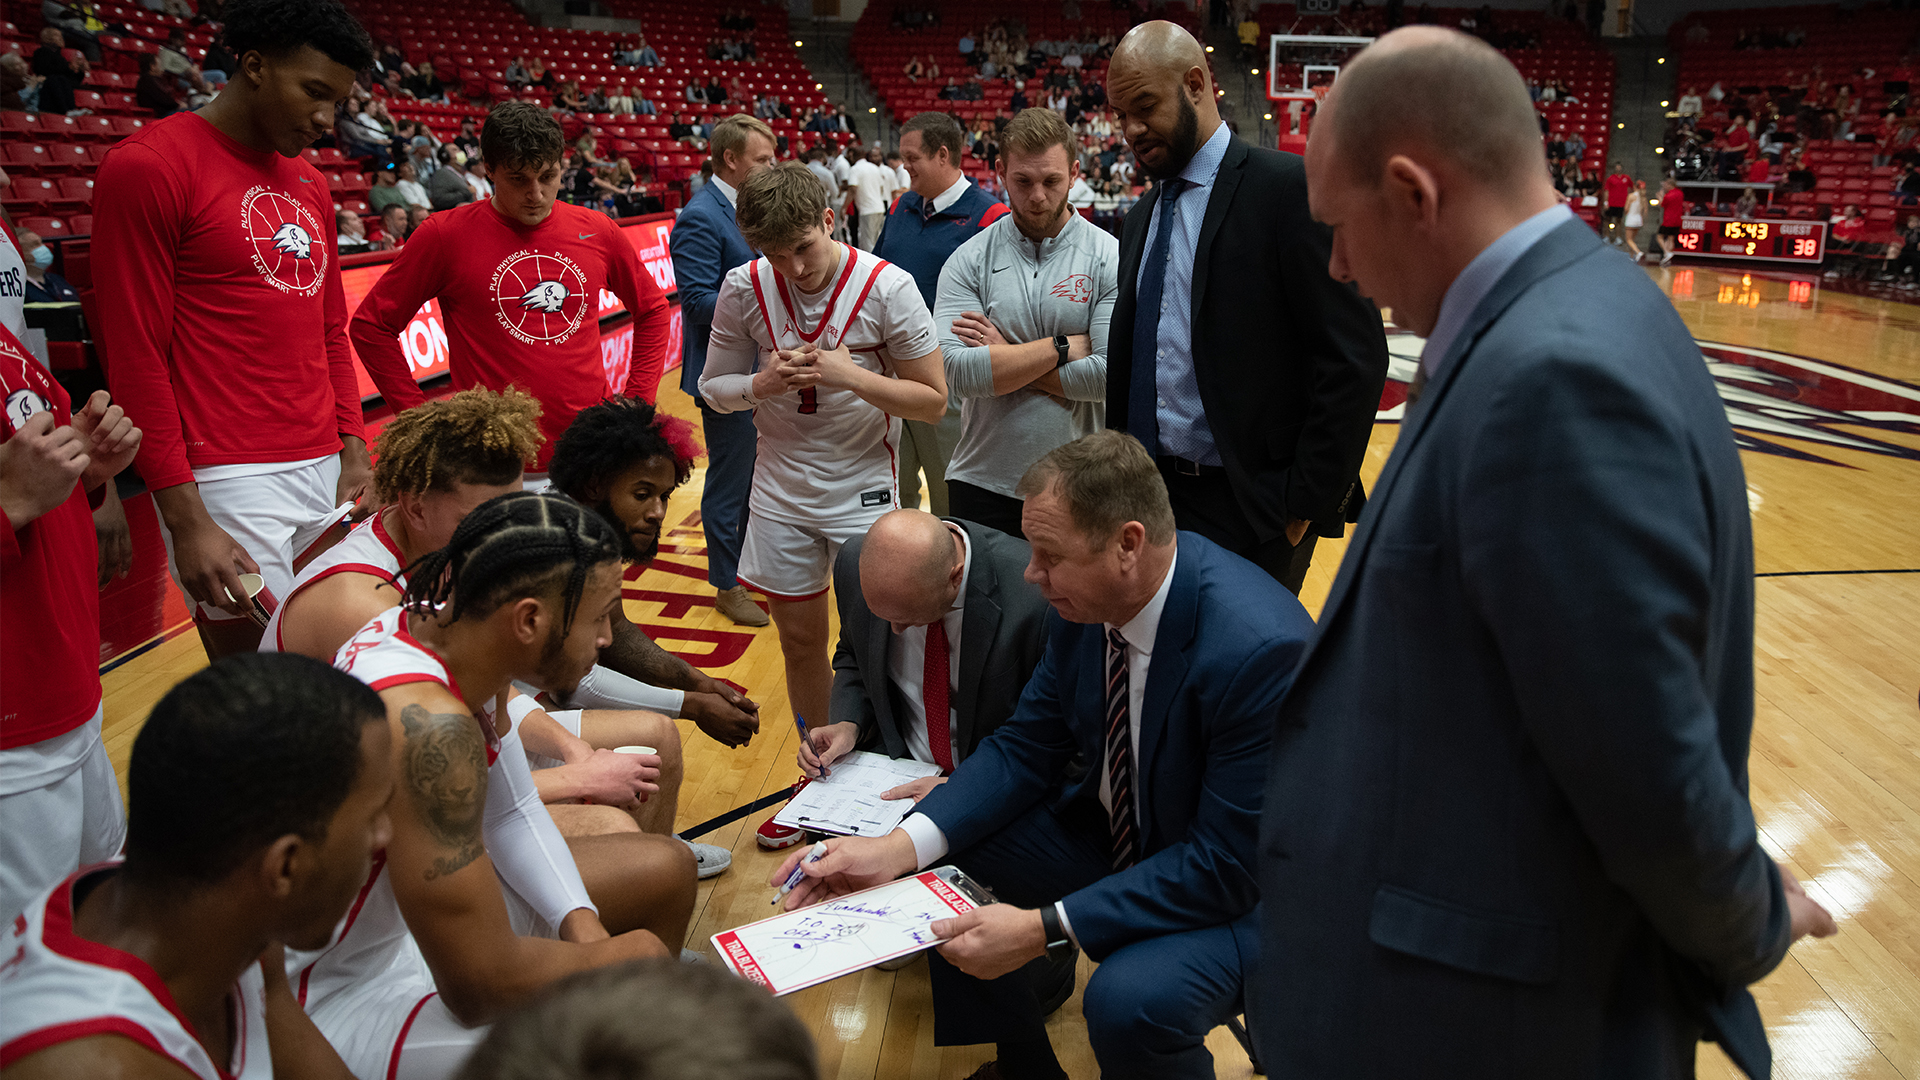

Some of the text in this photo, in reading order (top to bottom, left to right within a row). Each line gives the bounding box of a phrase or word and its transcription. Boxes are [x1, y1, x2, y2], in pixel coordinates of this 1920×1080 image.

[241, 185, 265, 229] PLAY PHYSICAL
[284, 191, 301, 207] PLAY
[1678, 233, 1699, 250] 42
[1725, 222, 1768, 240] 15:43
[1780, 224, 1812, 235] GUEST
[1746, 242, 1756, 255] 2
[1794, 239, 1817, 256] 38
[250, 254, 290, 294] PLAY SMART
[489, 249, 530, 291] PLAY PHYSICAL
[554, 251, 588, 284] PLAY HARD
[495, 312, 535, 346] PLAY SMART
[554, 302, 589, 346] PLAY TOGETHER
[928, 879, 973, 914] TRAILBLAZE
